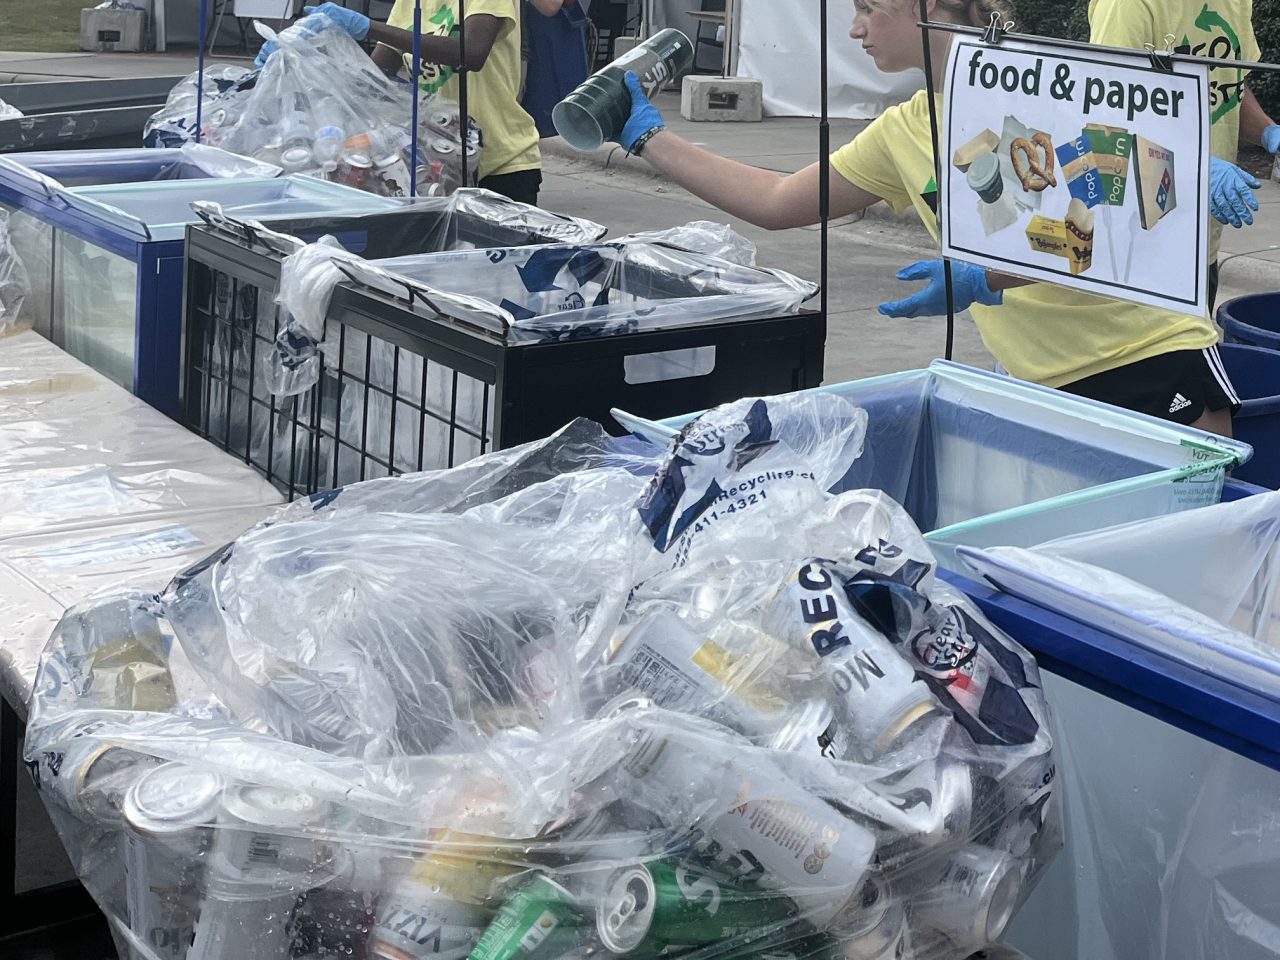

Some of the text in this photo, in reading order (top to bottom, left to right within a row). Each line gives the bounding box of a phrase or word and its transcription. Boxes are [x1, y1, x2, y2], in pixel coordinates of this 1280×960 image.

[968, 50, 1043, 96] food
[1049, 63, 1076, 102] &
[1082, 76, 1184, 121] paper
[1169, 400, 1192, 413] adidas
